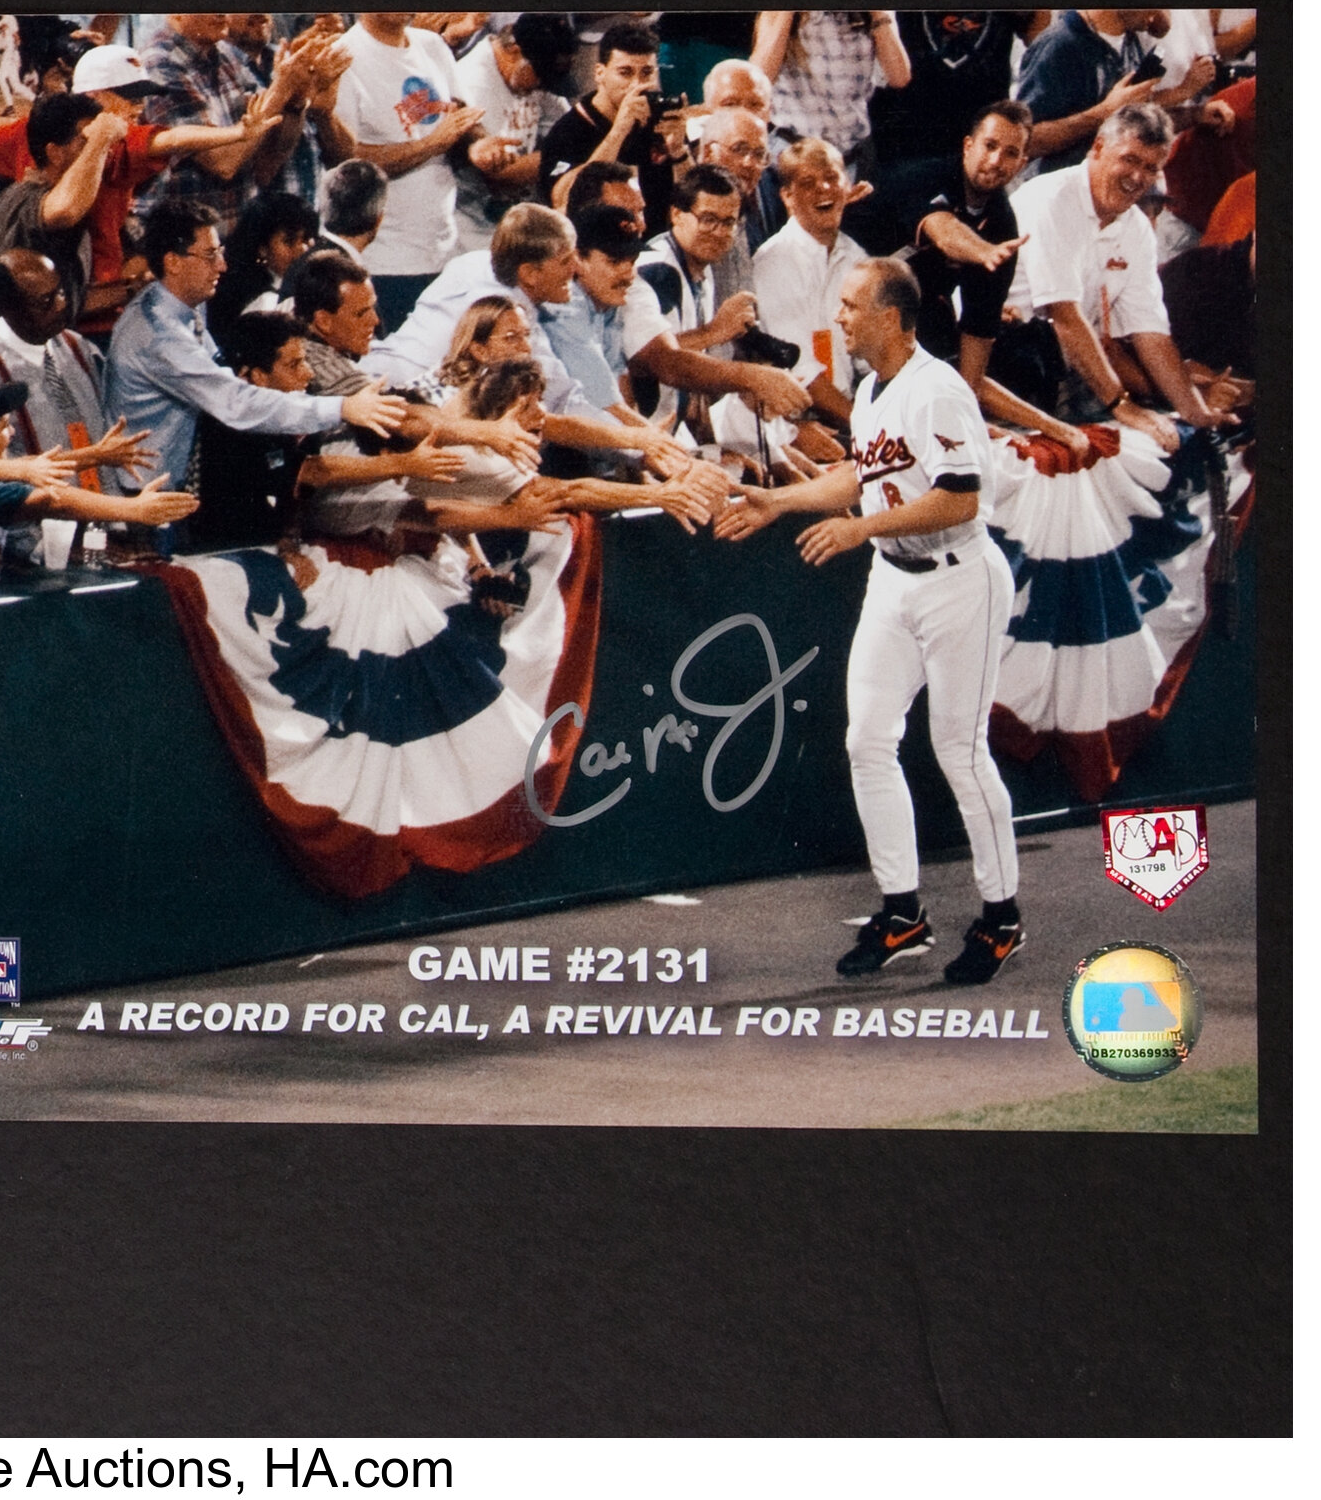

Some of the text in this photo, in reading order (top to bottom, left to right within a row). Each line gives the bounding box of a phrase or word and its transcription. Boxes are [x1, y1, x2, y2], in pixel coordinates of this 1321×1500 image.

[1129, 862, 1167, 874] 131798
[1131, 884, 1153, 903] SEAL
[1154, 899, 1166, 907] IS
[1166, 884, 1183, 899] THE
[1182, 865, 1205, 885] REAL
[408, 946, 709, 983] GAME #2131
[77, 1002, 1050, 1040] A RECORD FOR CAL, A REVIVAL FOR BASEBALL
